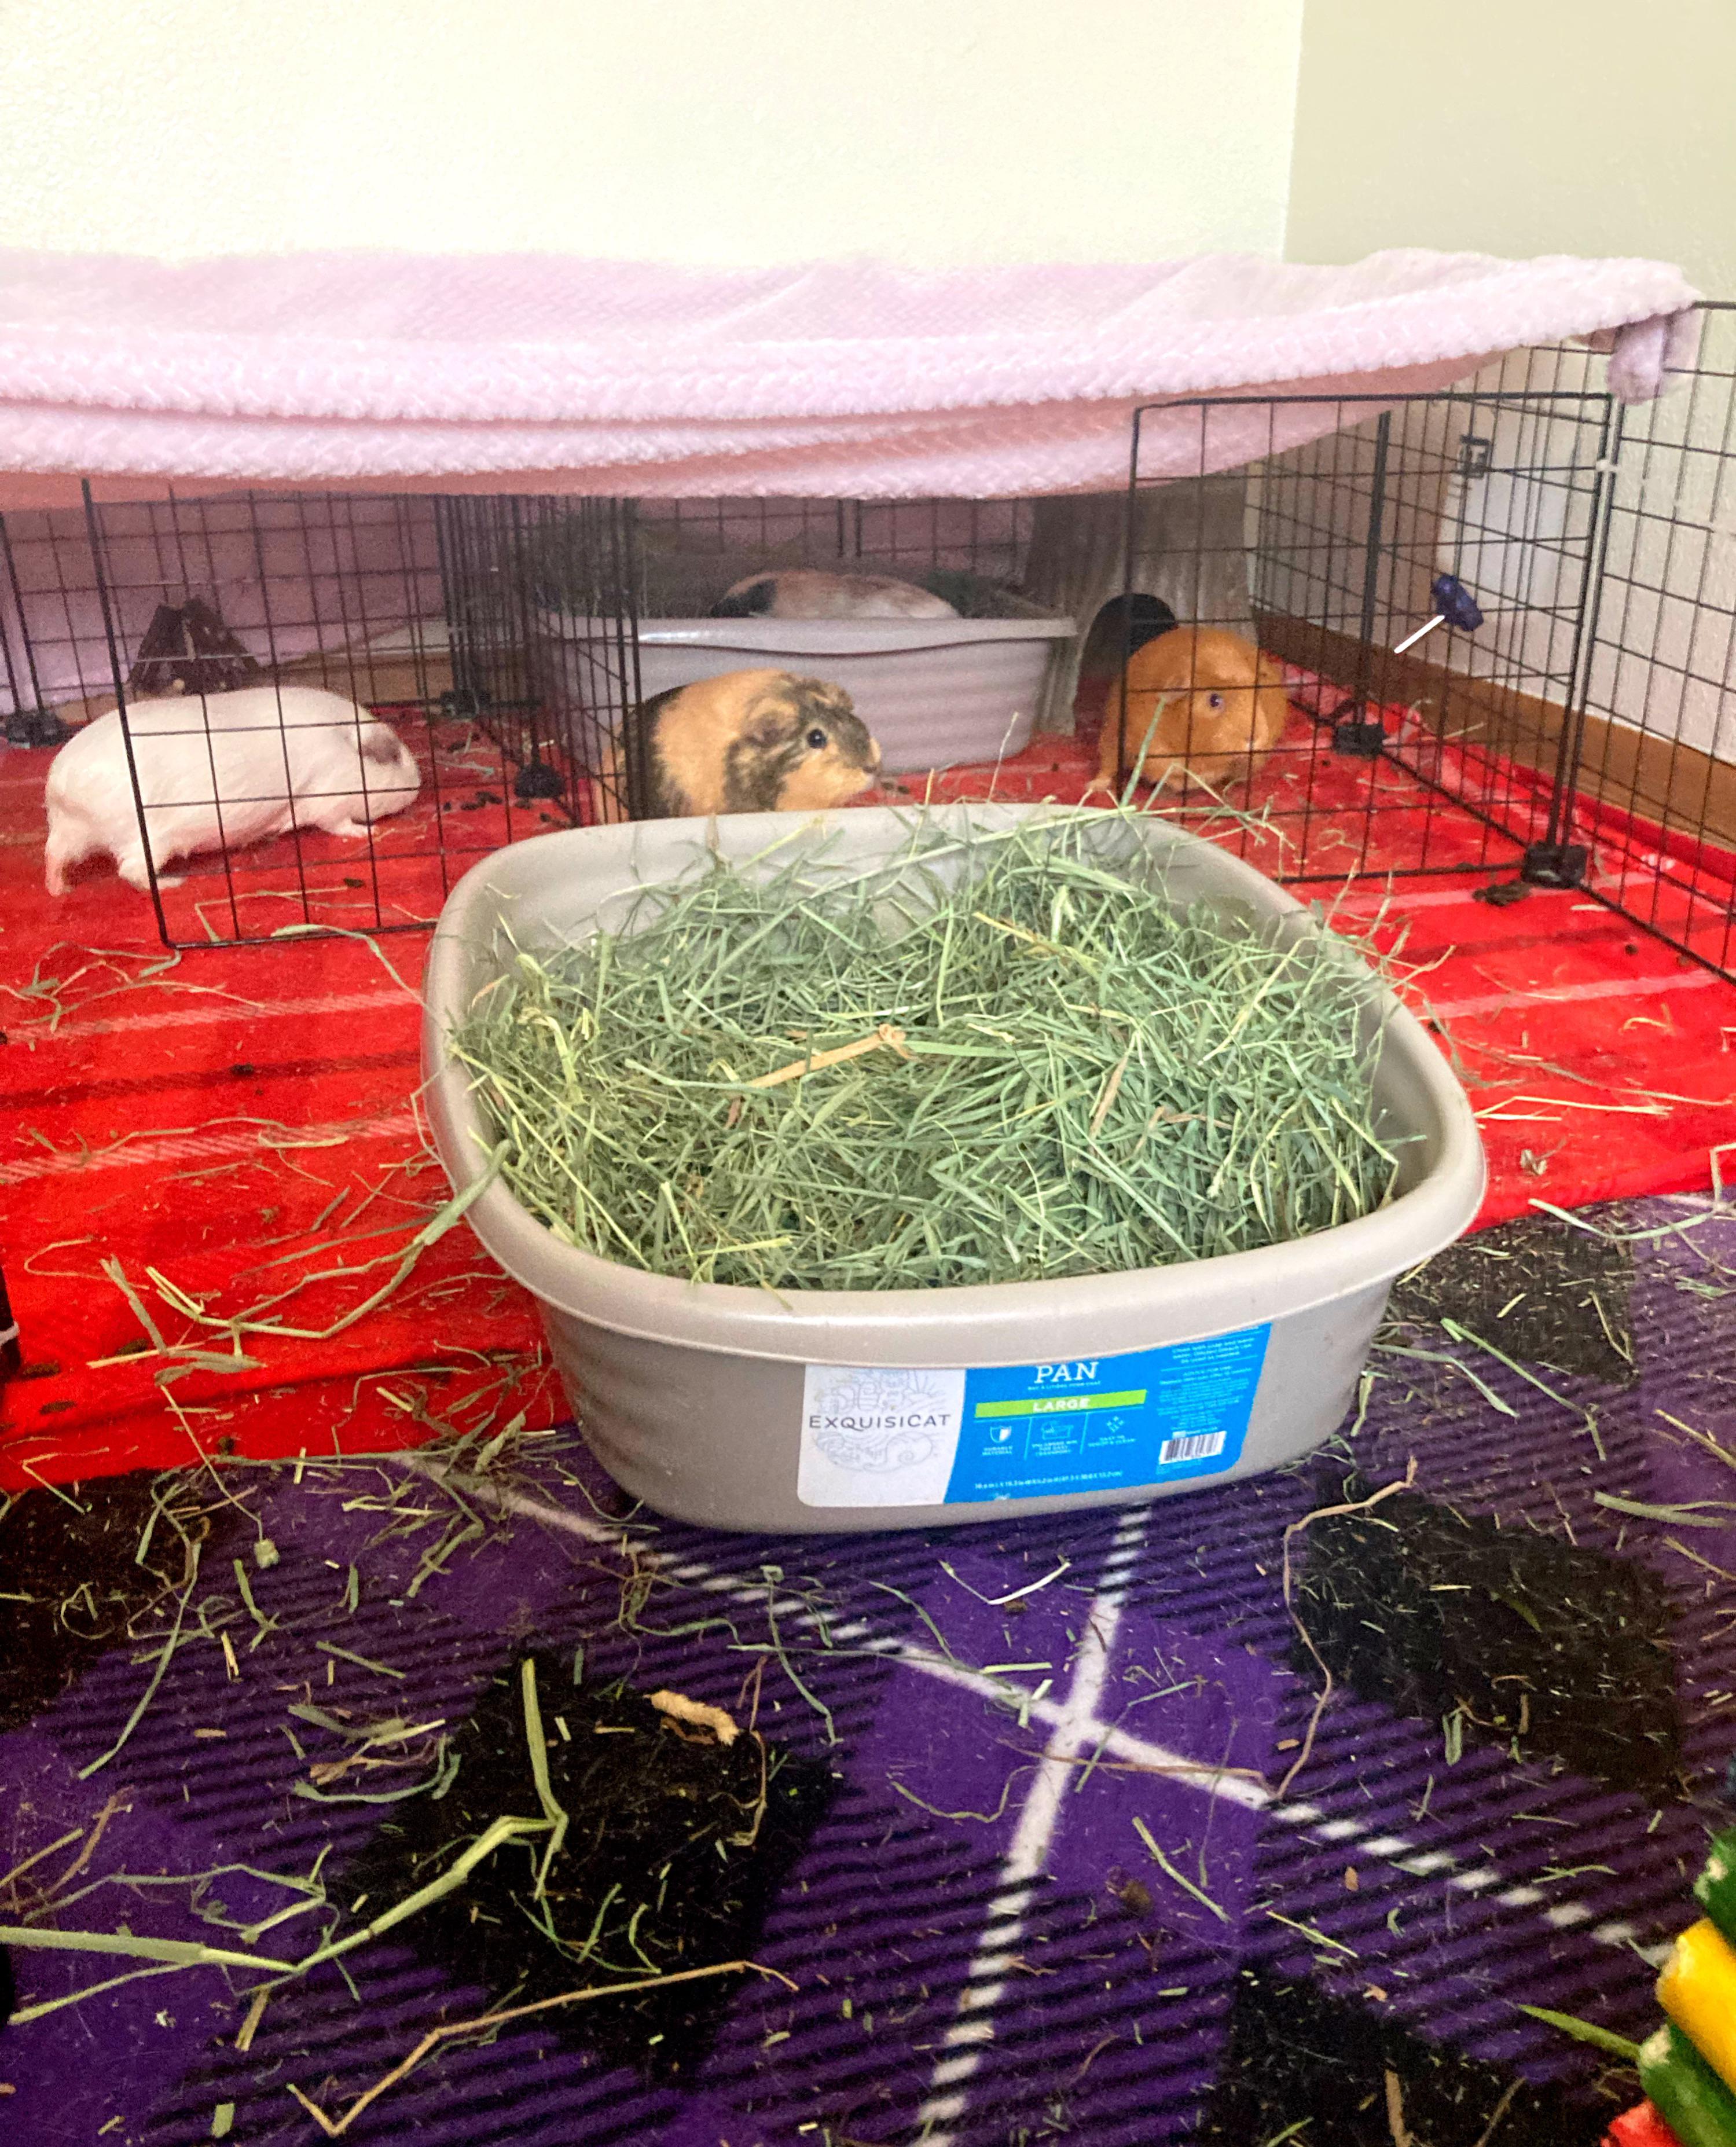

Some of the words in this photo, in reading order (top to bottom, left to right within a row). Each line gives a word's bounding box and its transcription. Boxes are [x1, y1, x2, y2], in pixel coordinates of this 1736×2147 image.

[1034, 1362, 1098, 1383] PAN
[1033, 1398, 1090, 1411] LARGE
[809, 1414, 950, 1431] EXQUISICAT
